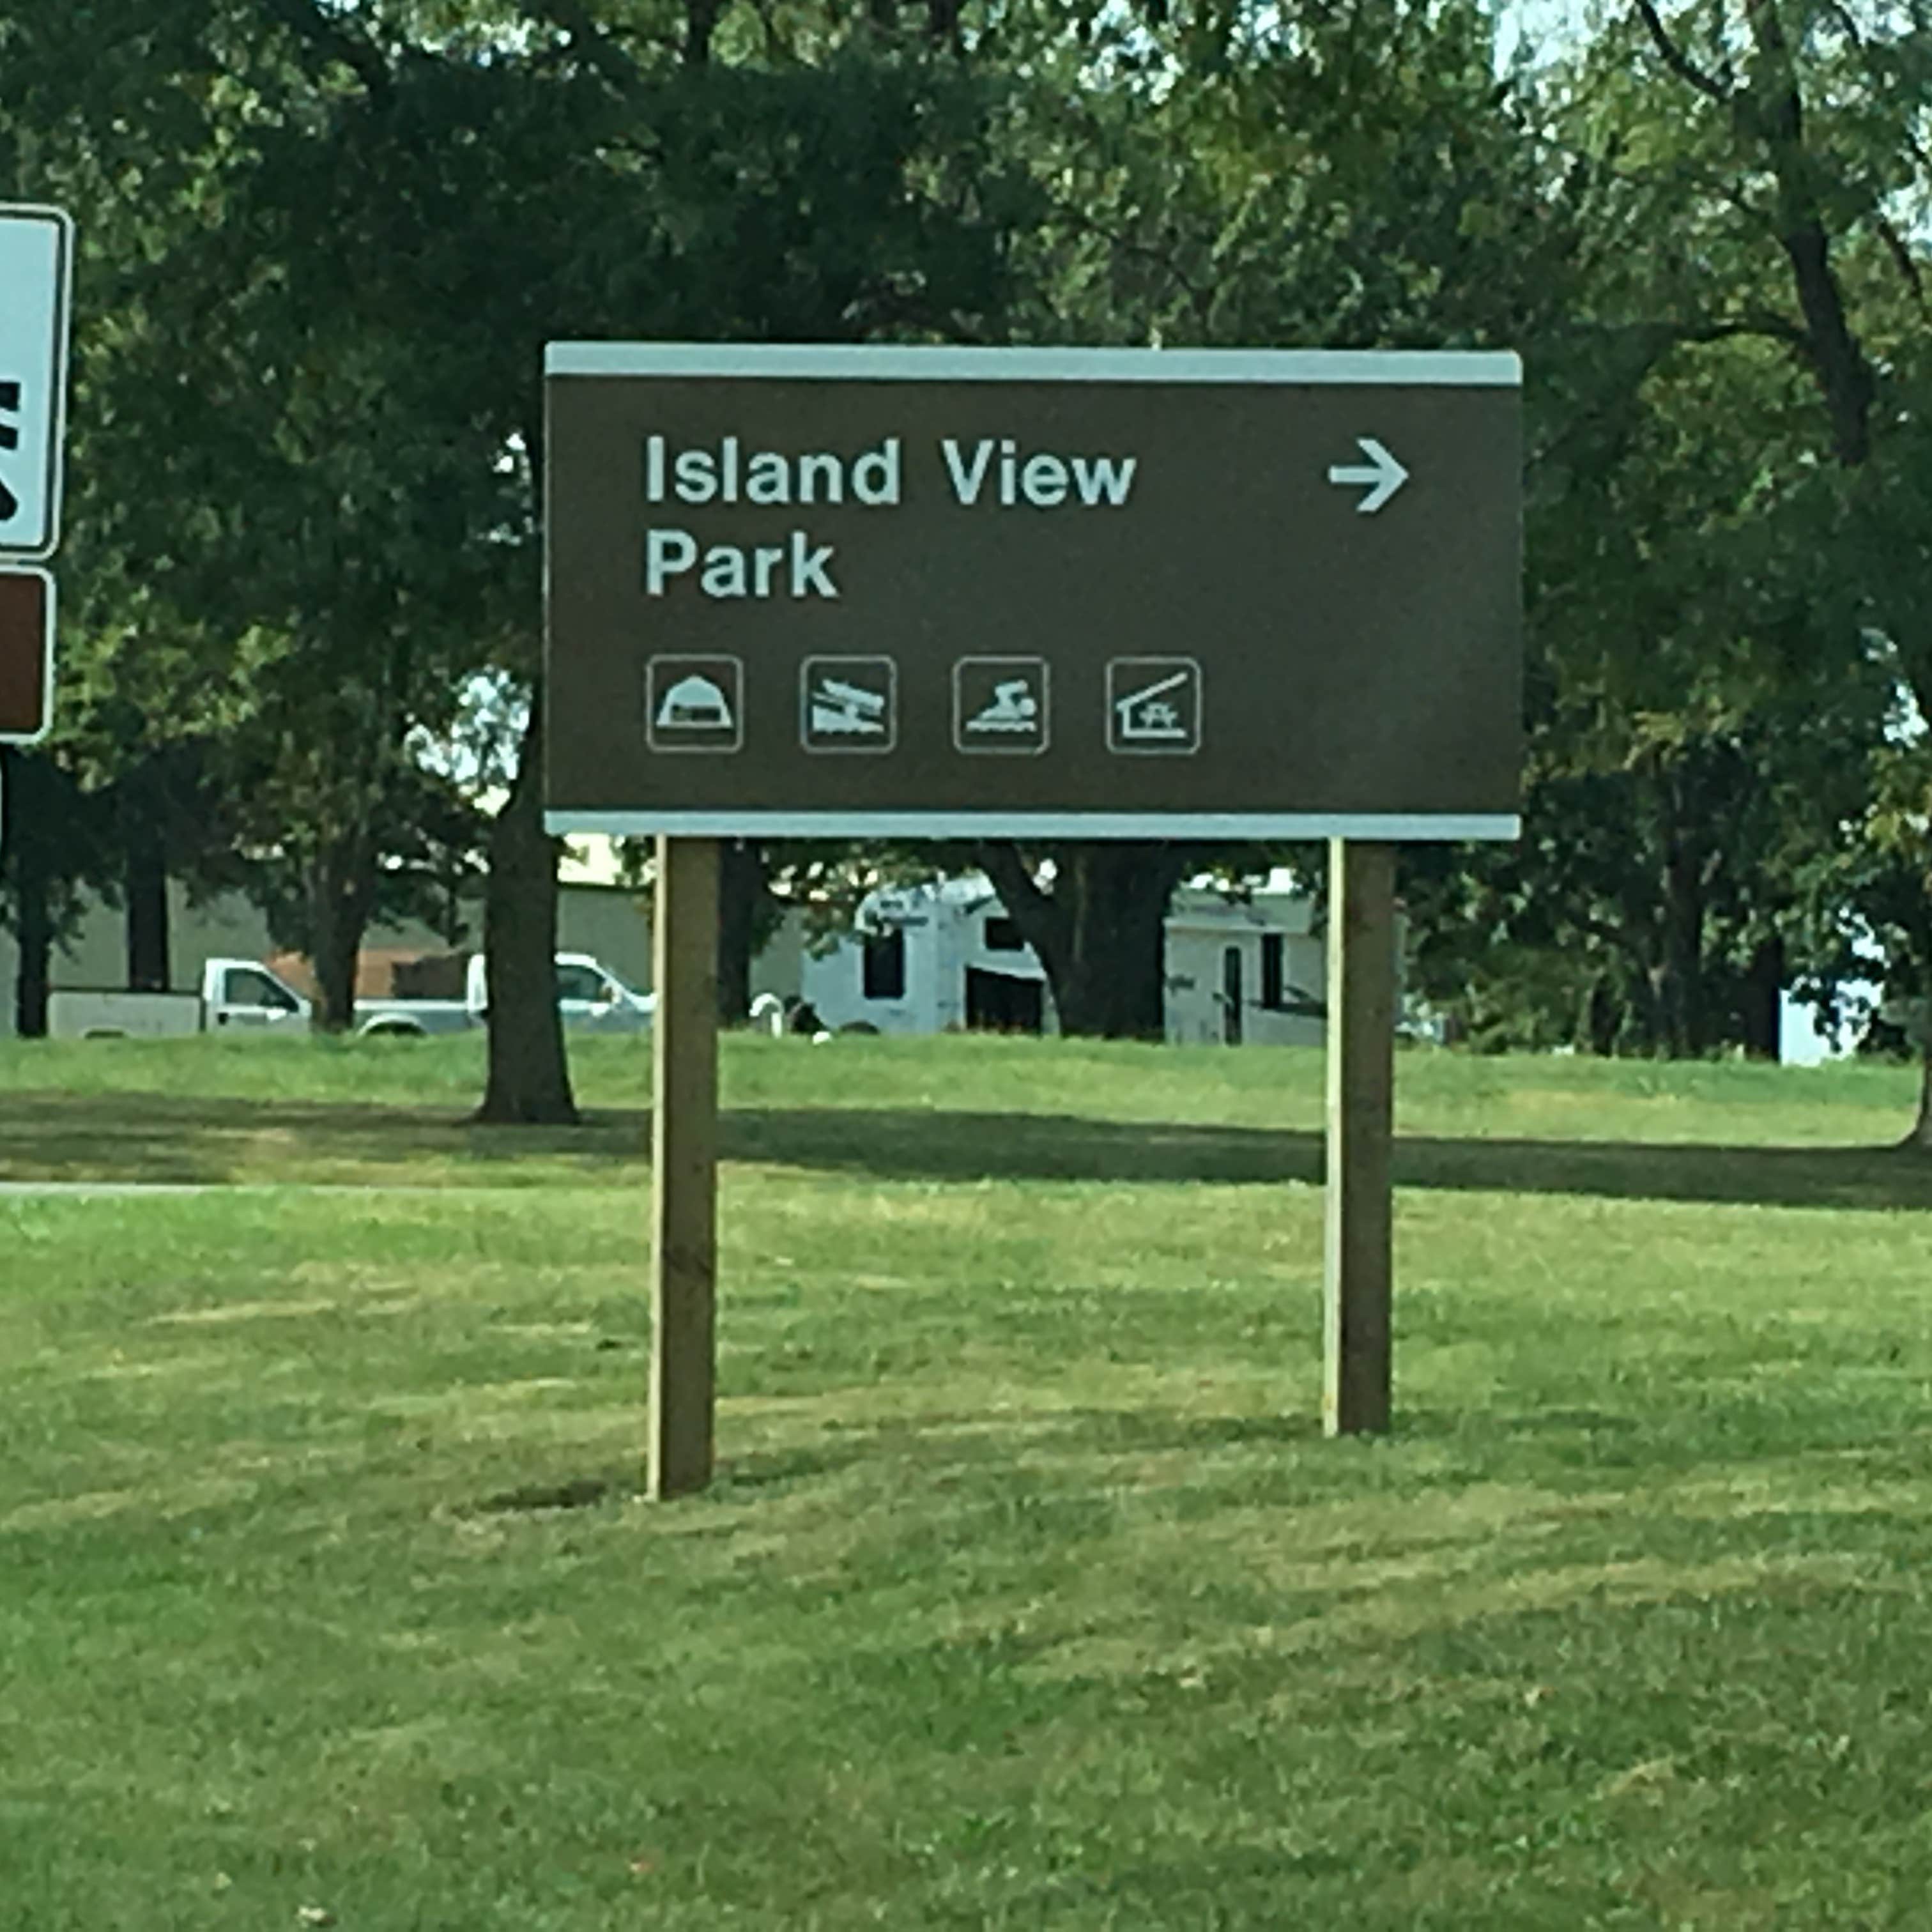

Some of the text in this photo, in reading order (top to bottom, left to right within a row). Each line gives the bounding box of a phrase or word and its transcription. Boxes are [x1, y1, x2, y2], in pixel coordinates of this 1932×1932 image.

[647, 436, 1137, 505] Island View
[647, 529, 838, 598] Park
